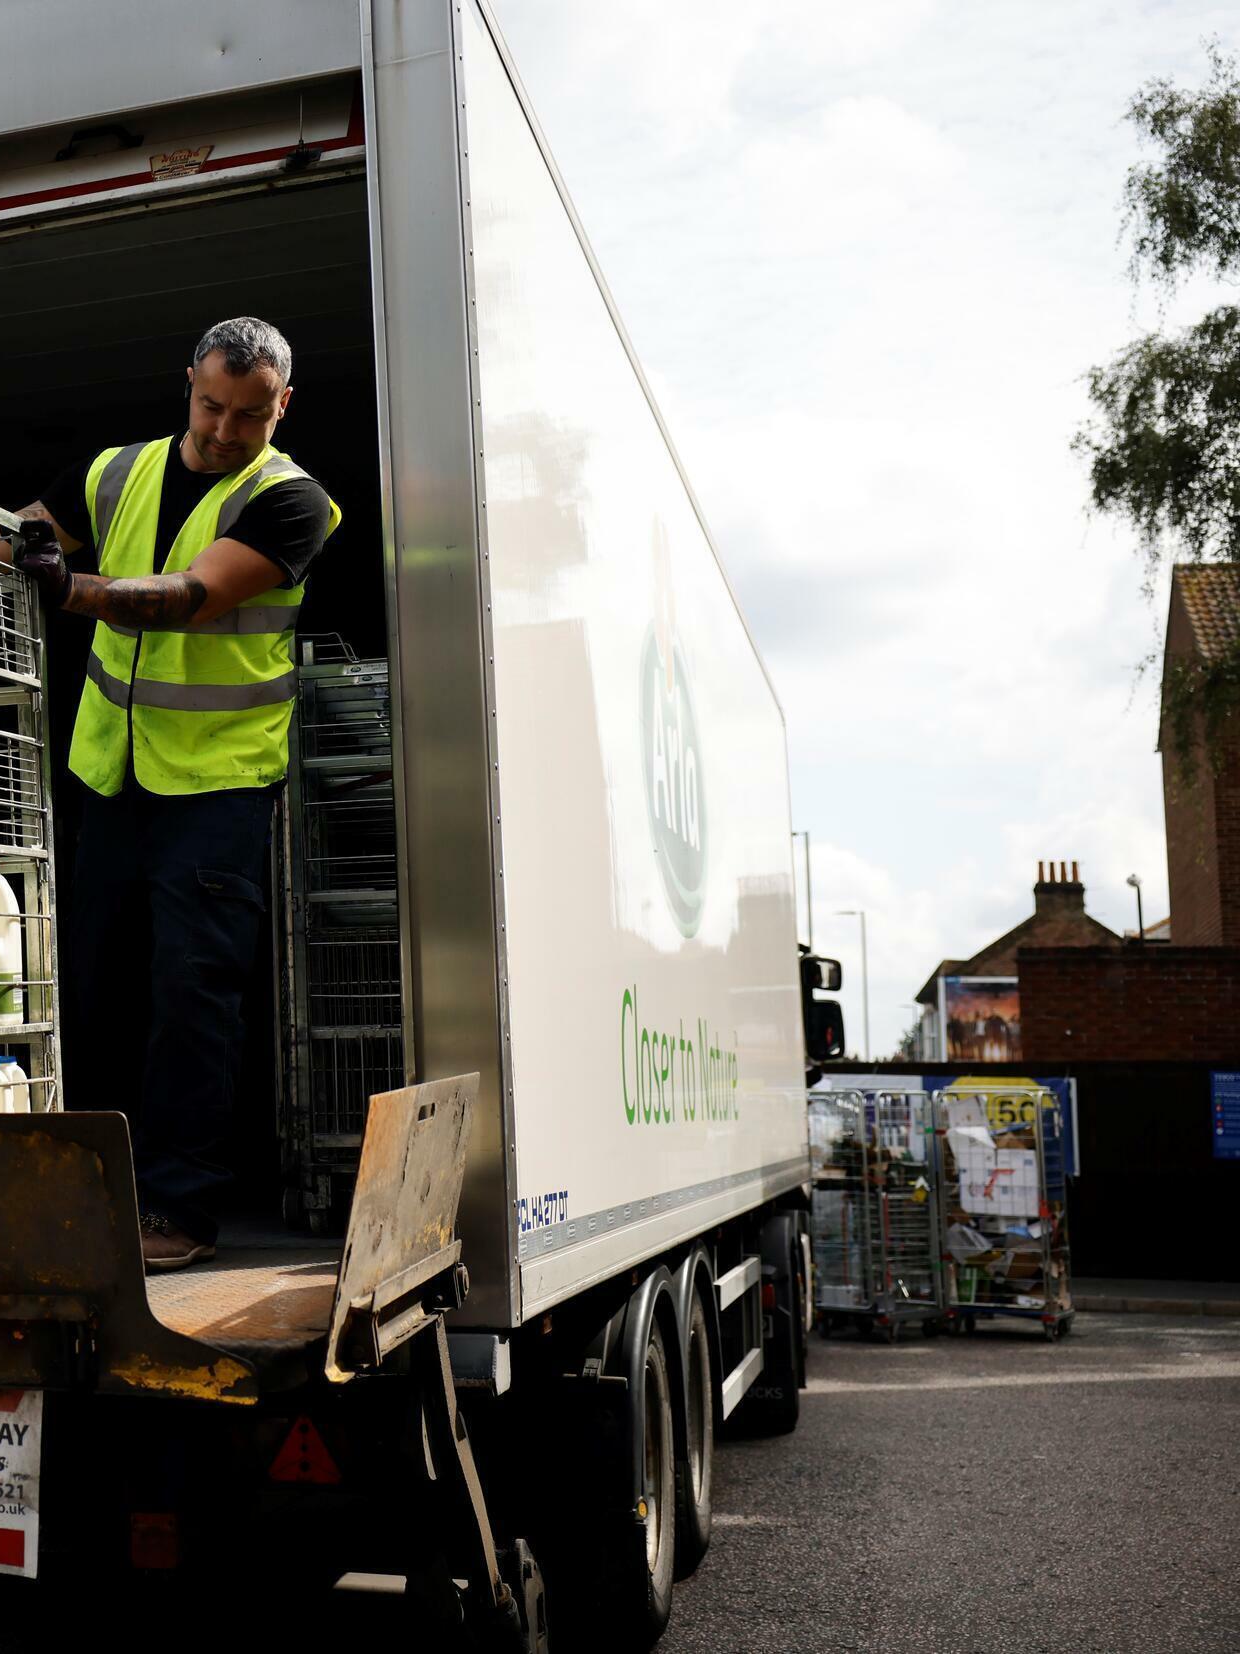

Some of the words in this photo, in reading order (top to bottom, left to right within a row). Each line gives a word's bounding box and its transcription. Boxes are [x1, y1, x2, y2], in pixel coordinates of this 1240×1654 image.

[653, 667, 701, 852] Arla
[621, 984, 675, 1125] Closer
[679, 1018, 696, 1121] to
[532, 1195, 544, 1229] HA
[544, 1192, 557, 1226] 277
[558, 1190, 568, 1221] DT
